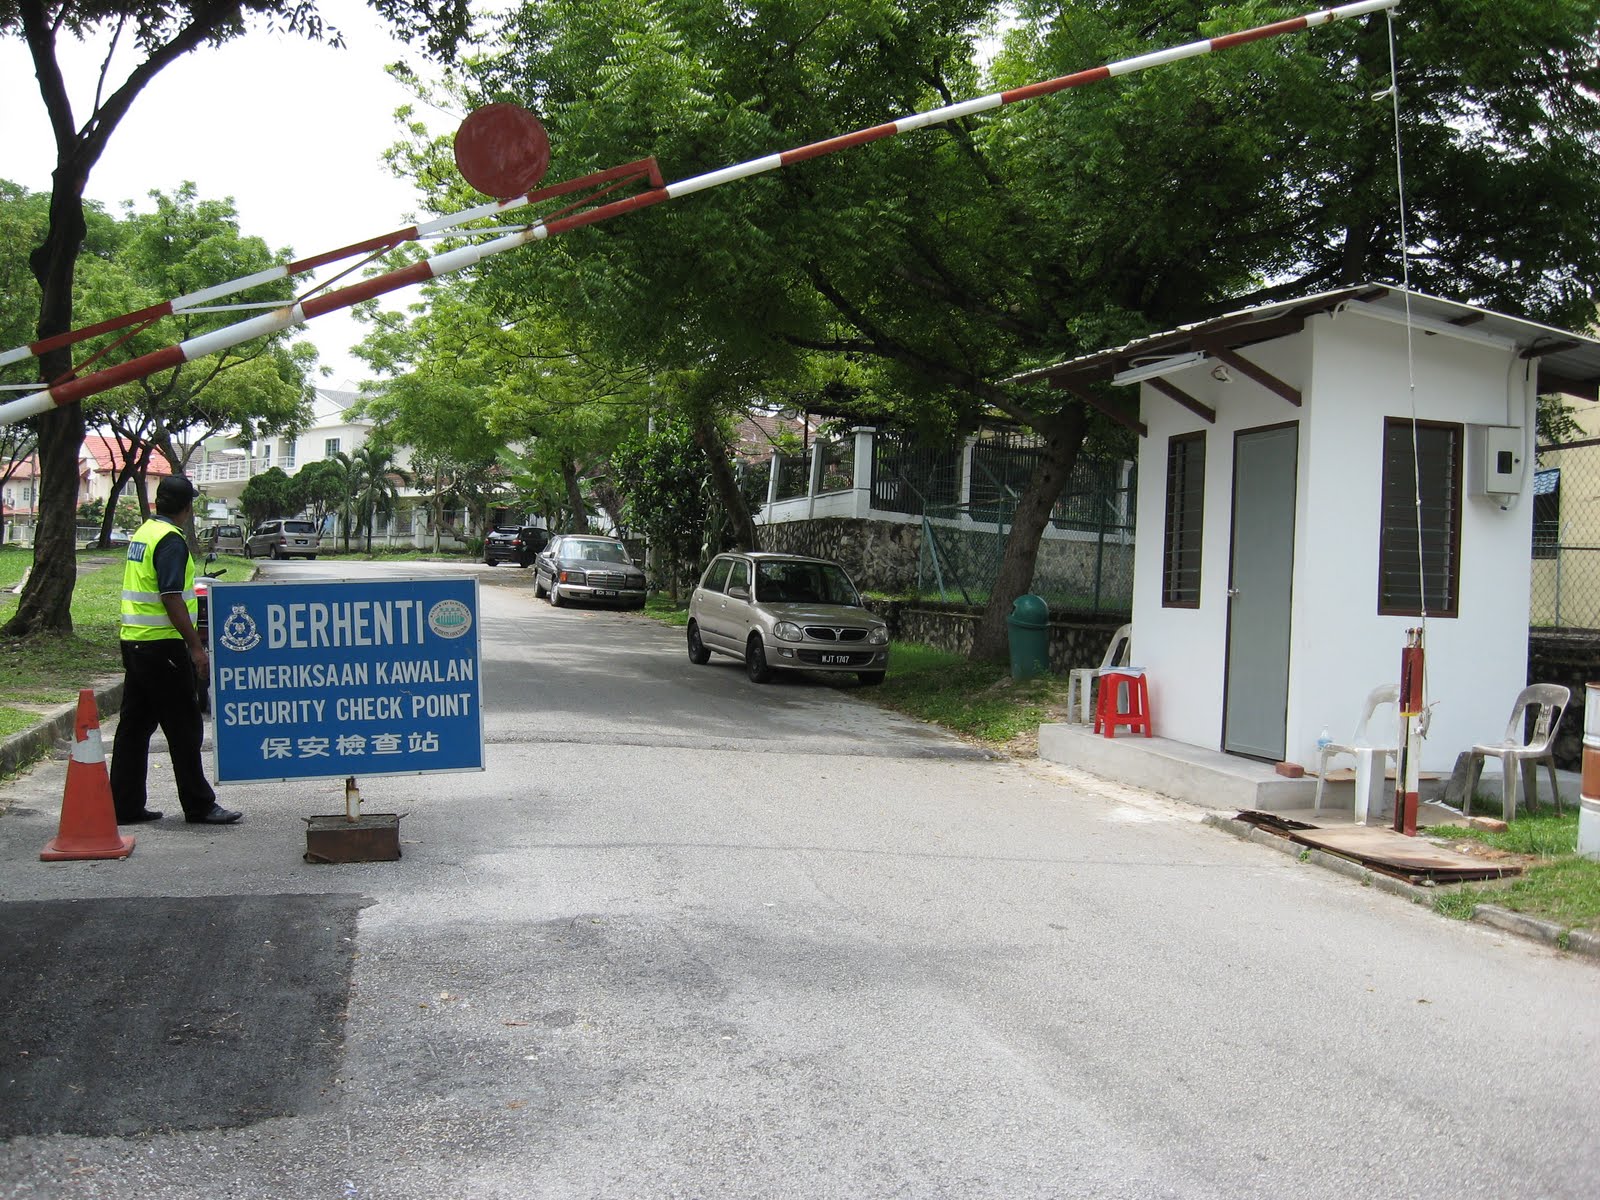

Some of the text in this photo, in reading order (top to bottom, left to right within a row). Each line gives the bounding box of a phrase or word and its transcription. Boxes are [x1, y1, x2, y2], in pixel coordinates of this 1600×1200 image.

[267, 600, 424, 649] BERHENTI
[219, 658, 473, 691] PEMERIKSAAN KAWALAN
[822, 655, 835, 663] WJT
[224, 693, 471, 726] SECURITY CHECK POINT
[260, 731, 439, 760] 保安檢查站
